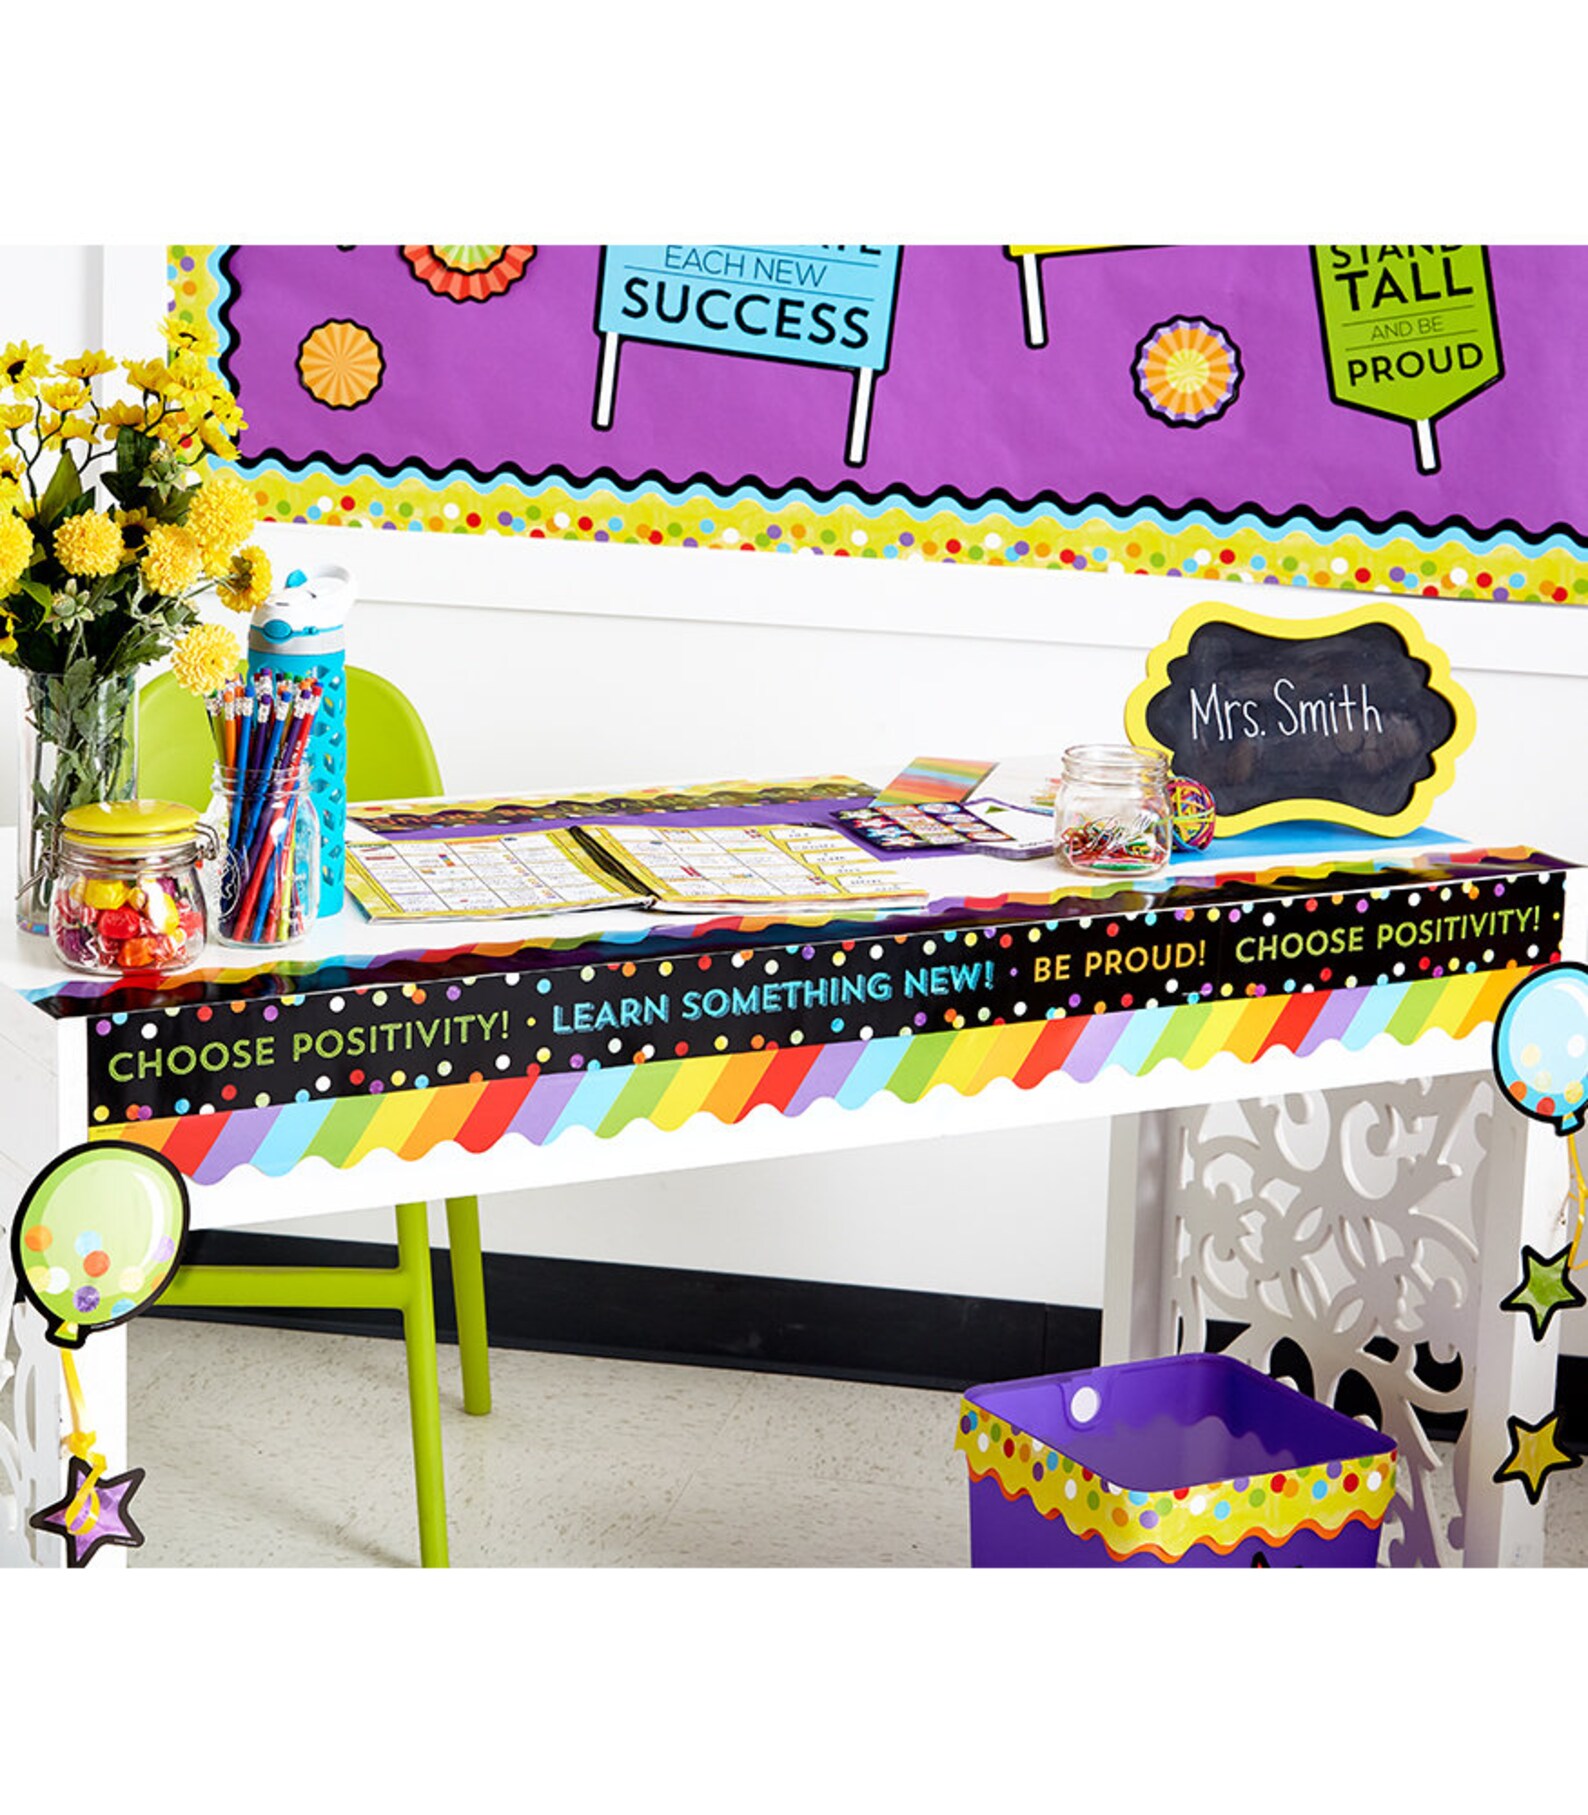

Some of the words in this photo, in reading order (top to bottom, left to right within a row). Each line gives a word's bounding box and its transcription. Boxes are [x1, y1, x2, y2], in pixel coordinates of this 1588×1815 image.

[664, 246, 744, 277] EACH
[754, 257, 827, 287] NEW
[1331, 245, 1462, 268] STA
[1335, 257, 1473, 311] TALL
[622, 278, 868, 348] SUCCESS
[1371, 321, 1413, 341] AND
[1418, 316, 1444, 335] BE
[1348, 343, 1483, 386] PROUD
[1191, 683, 1265, 740] Mrs.
[1274, 679, 1382, 736] Smith
[1236, 927, 1364, 963] CHOOSE
[1377, 906, 1539, 949] POSITIVITY!
[109, 1037, 274, 1081] CHOOSE
[293, 1010, 508, 1062] POSITIVITY!
[553, 994, 669, 1034] LEARN
[682, 972, 892, 1021] SOMETHING
[904, 960, 994, 998] NEW!
[1034, 955, 1071, 982] BE
[1085, 940, 1205, 977] PROUD!
